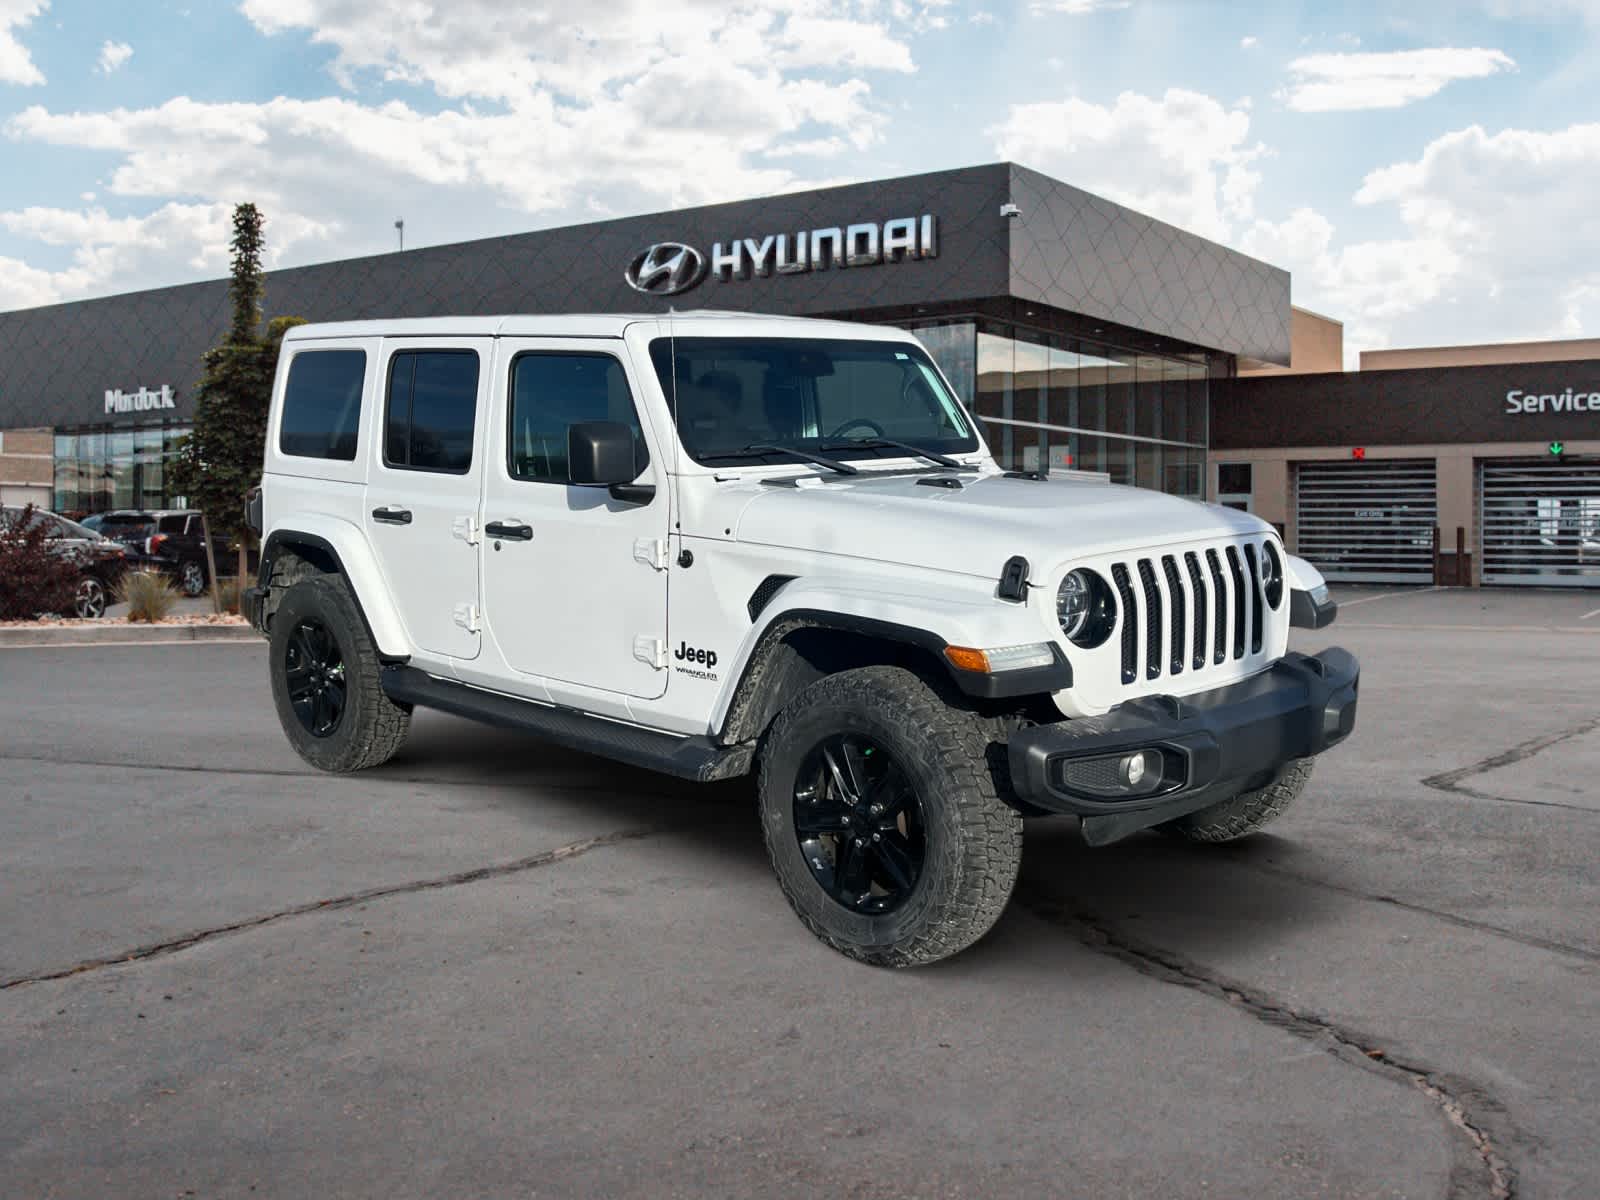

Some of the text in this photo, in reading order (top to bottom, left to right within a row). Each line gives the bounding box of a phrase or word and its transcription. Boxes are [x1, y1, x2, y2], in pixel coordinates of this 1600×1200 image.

[712, 214, 937, 281] HYUNDAI
[105, 384, 176, 414] Murdock
[1505, 387, 1600, 413] Service
[675, 640, 718, 669] Jeep
